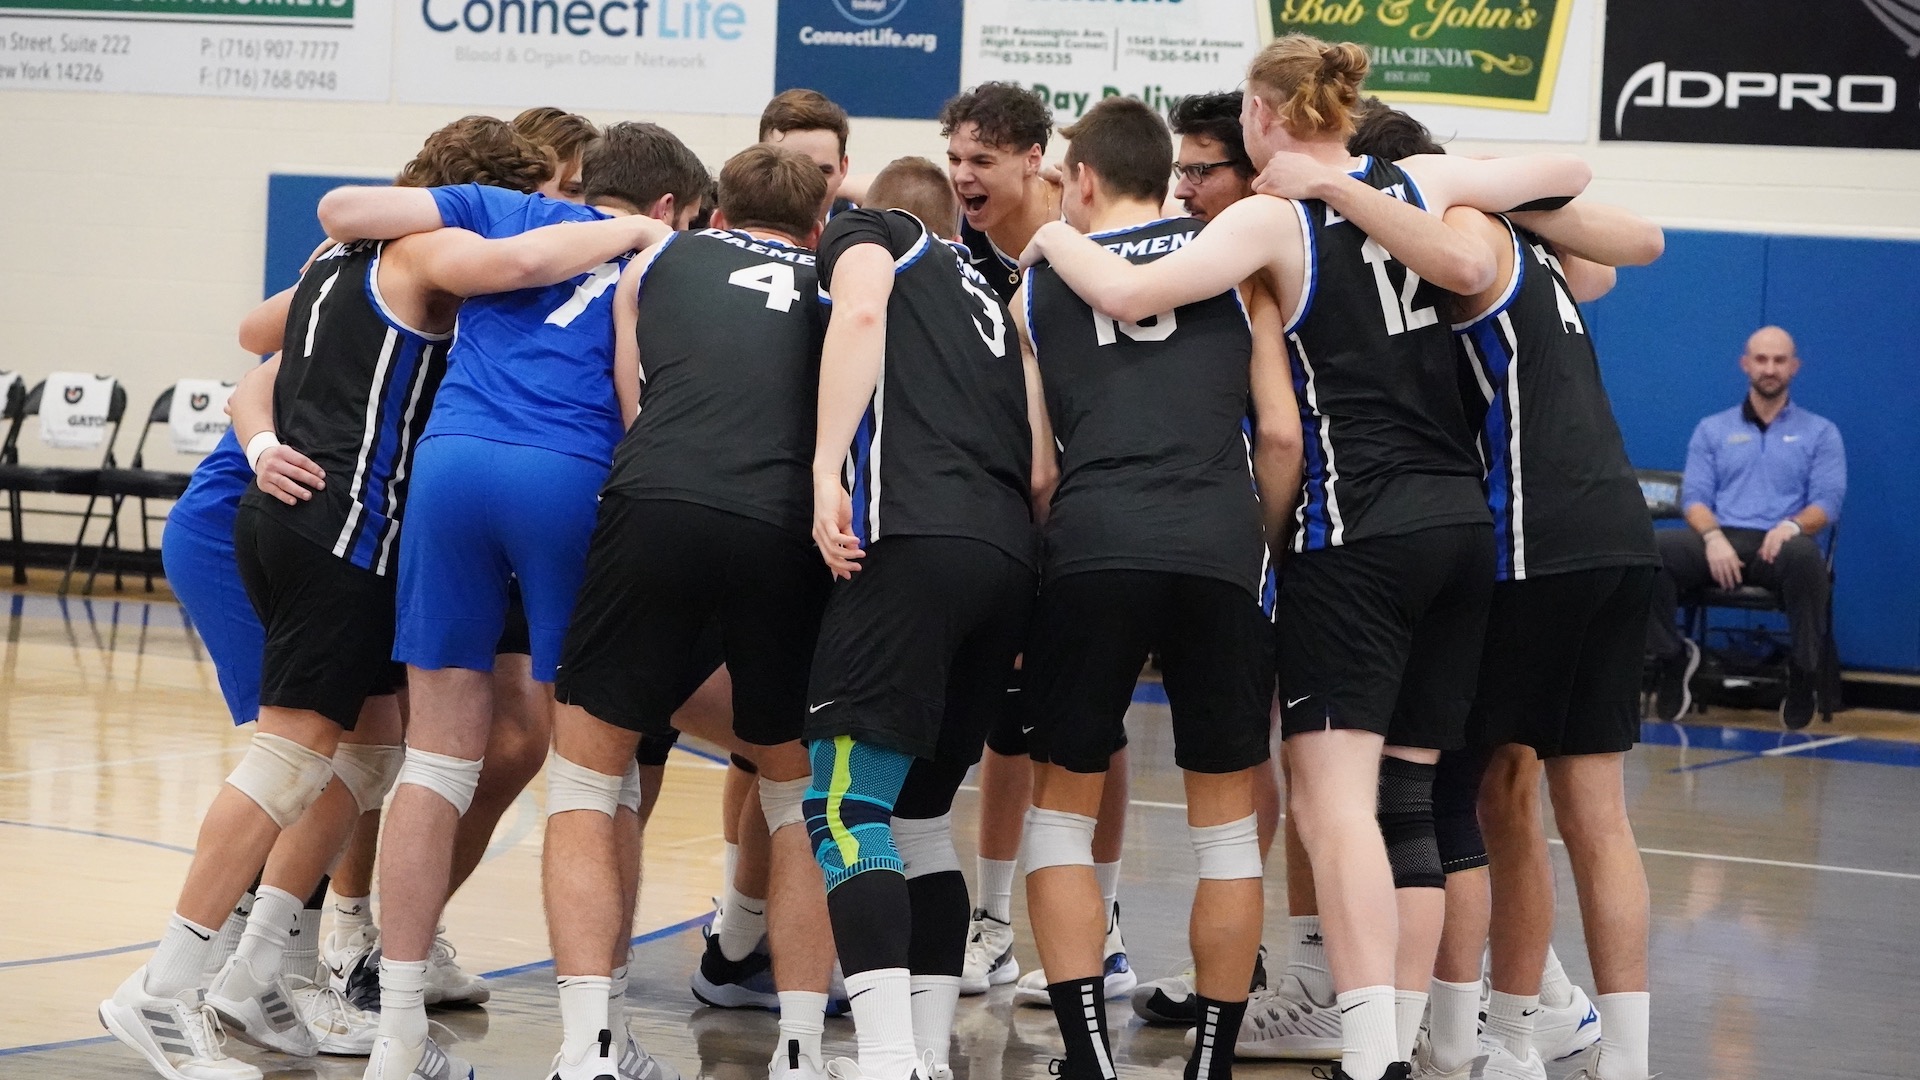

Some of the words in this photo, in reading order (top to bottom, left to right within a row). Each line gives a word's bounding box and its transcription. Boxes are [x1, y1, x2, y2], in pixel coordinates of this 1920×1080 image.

[1280, 0, 1365, 24] Bob
[1376, 0, 1409, 26] &
[10, 32, 56, 53] Street,
[60, 33, 98, 52] Suite
[102, 34, 131, 54] 222
[799, 26, 937, 52] ConnectLife.org
[1013, 27, 1080, 38] Kensington
[1200, 38, 1244, 48] Avenue
[218, 38, 260, 60] (716)
[455, 46, 501, 63] Blood
[506, 48, 518, 63] &
[523, 48, 573, 68] Organ
[579, 49, 629, 67] Donor
[634, 51, 706, 69] Network
[1372, 46, 1474, 67] HACIENDA
[20, 60, 50, 79] York
[57, 63, 103, 82] 14226
[216, 67, 259, 91] (716)
[1032, 83, 1089, 118] Day
[1615, 61, 1897, 138] ADPRO
[728, 262, 801, 313] 4
[1361, 236, 1439, 336] 12
[304, 266, 341, 358] 1
[961, 277, 1007, 359] 3
